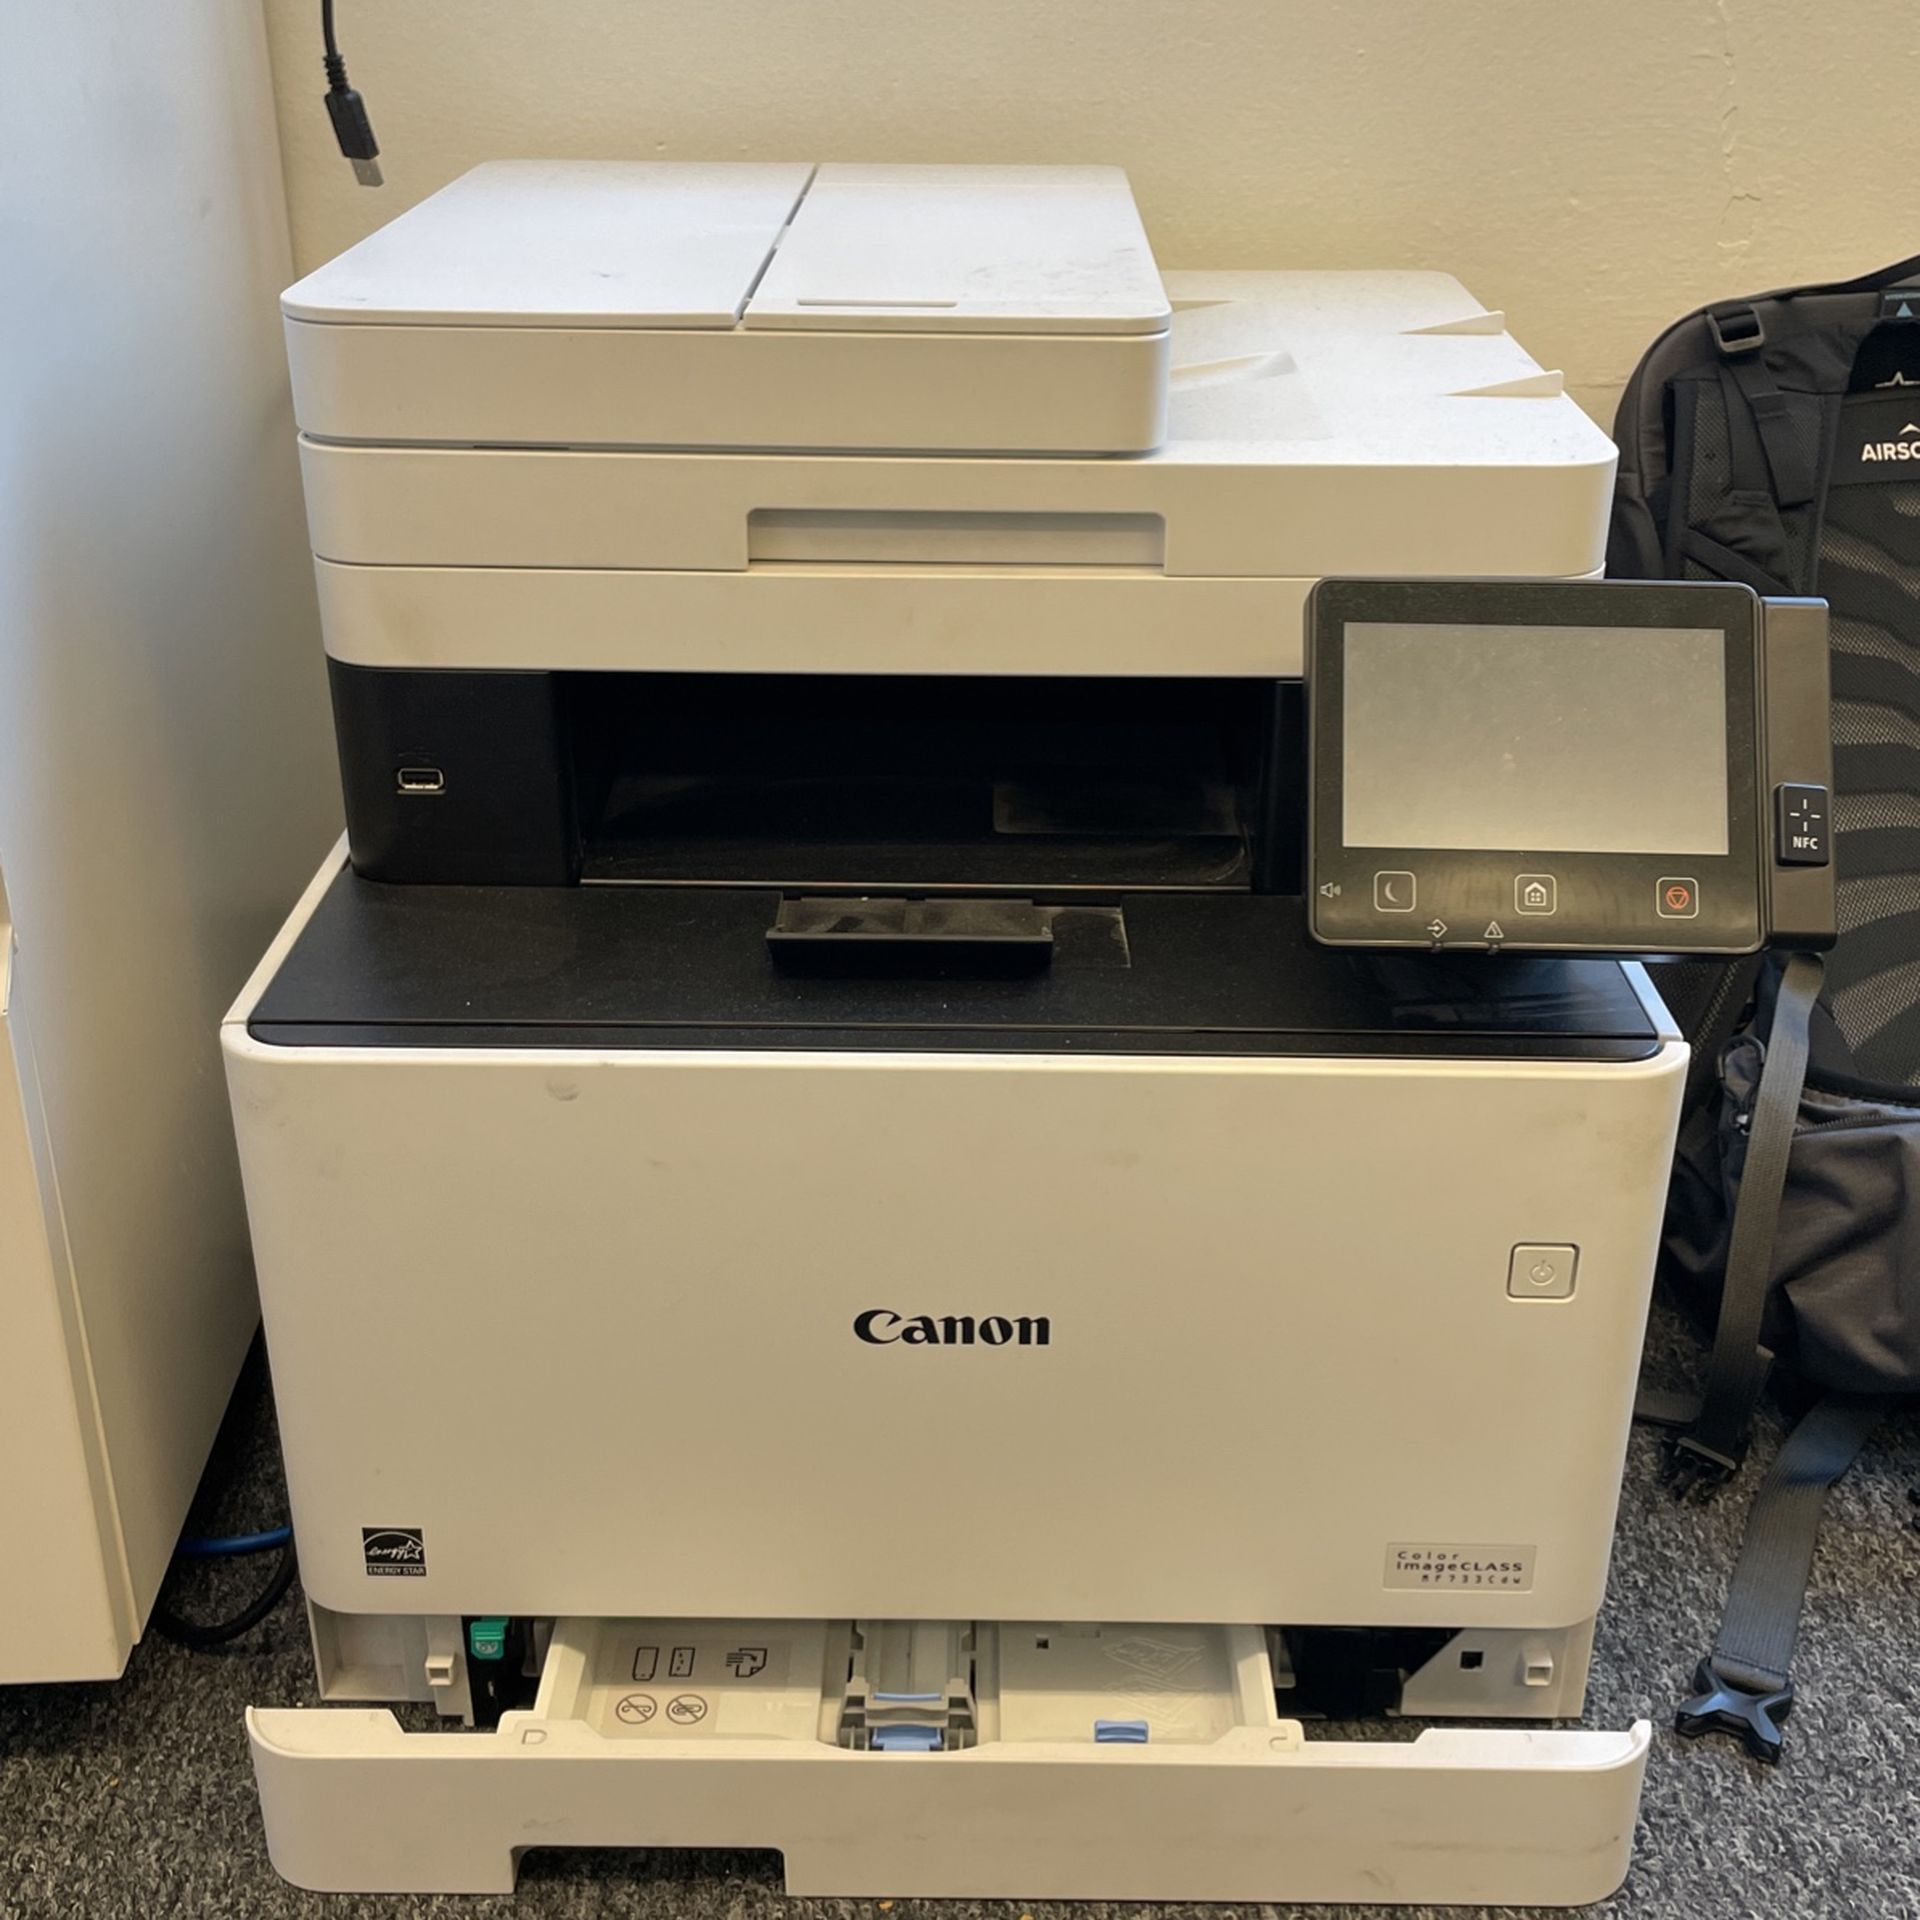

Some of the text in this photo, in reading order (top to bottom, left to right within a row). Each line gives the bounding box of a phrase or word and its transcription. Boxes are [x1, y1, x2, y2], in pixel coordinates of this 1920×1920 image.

[1793, 836, 1818, 850] NFC
[854, 1309, 1050, 1346] Canon
[1397, 1551, 1459, 1561] Color
[368, 1567, 425, 1575] ENERGY STAR
